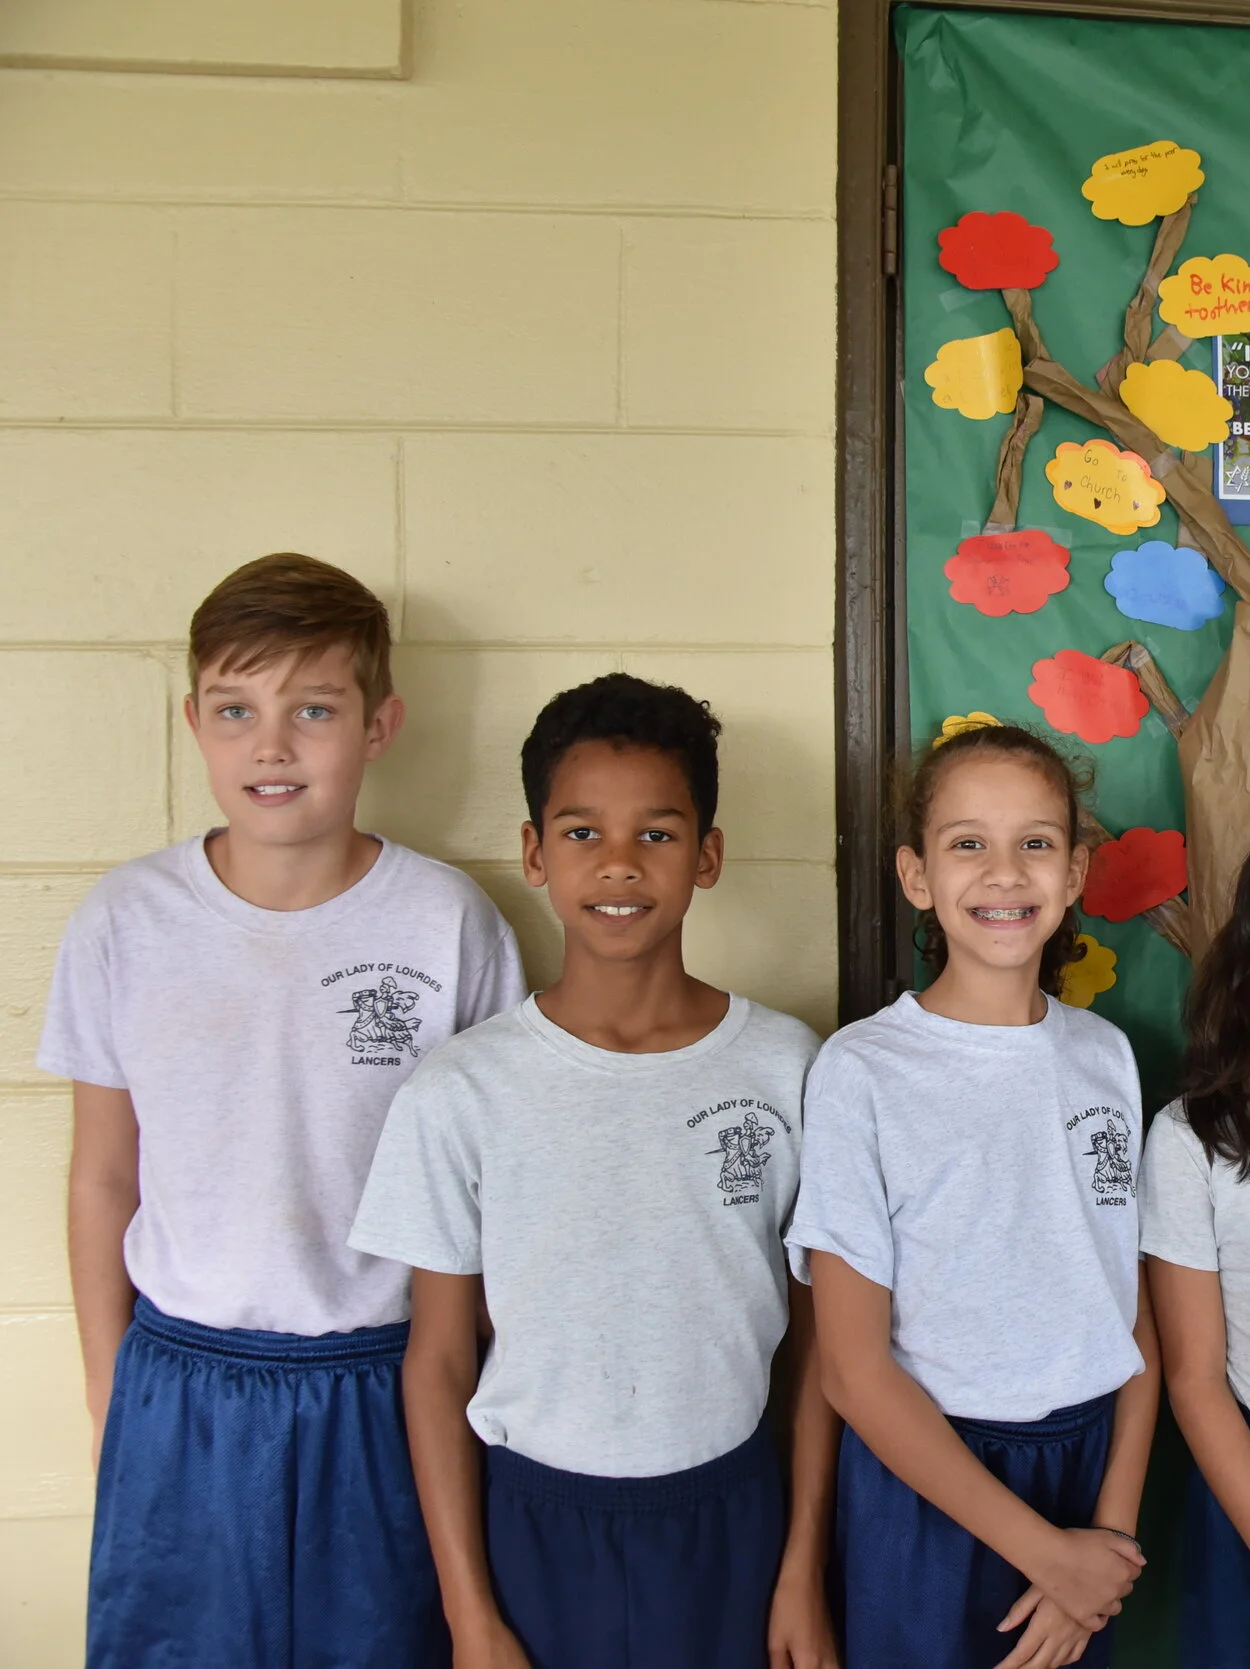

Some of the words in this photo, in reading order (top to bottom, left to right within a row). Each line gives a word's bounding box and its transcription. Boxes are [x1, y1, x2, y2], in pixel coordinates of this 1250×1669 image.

[1190, 273, 1212, 295] Be
[1226, 384, 1250, 397] THE
[1084, 449, 1099, 466] Go
[320, 971, 345, 987] OUR
[345, 963, 375, 976] LADY
[377, 963, 394, 972] OF
[395, 965, 443, 993] LOURDES
[351, 1056, 402, 1066] LANCERS
[686, 1110, 709, 1128] OUR
[709, 1099, 737, 1115] LADY
[739, 1098, 755, 1108] OF
[1066, 1115, 1081, 1131] OUR
[1080, 1106, 1100, 1120] LADY
[1101, 1106, 1111, 1115] OF
[723, 1193, 760, 1206] LANCERS
[1095, 1197, 1127, 1206] LANCERS
